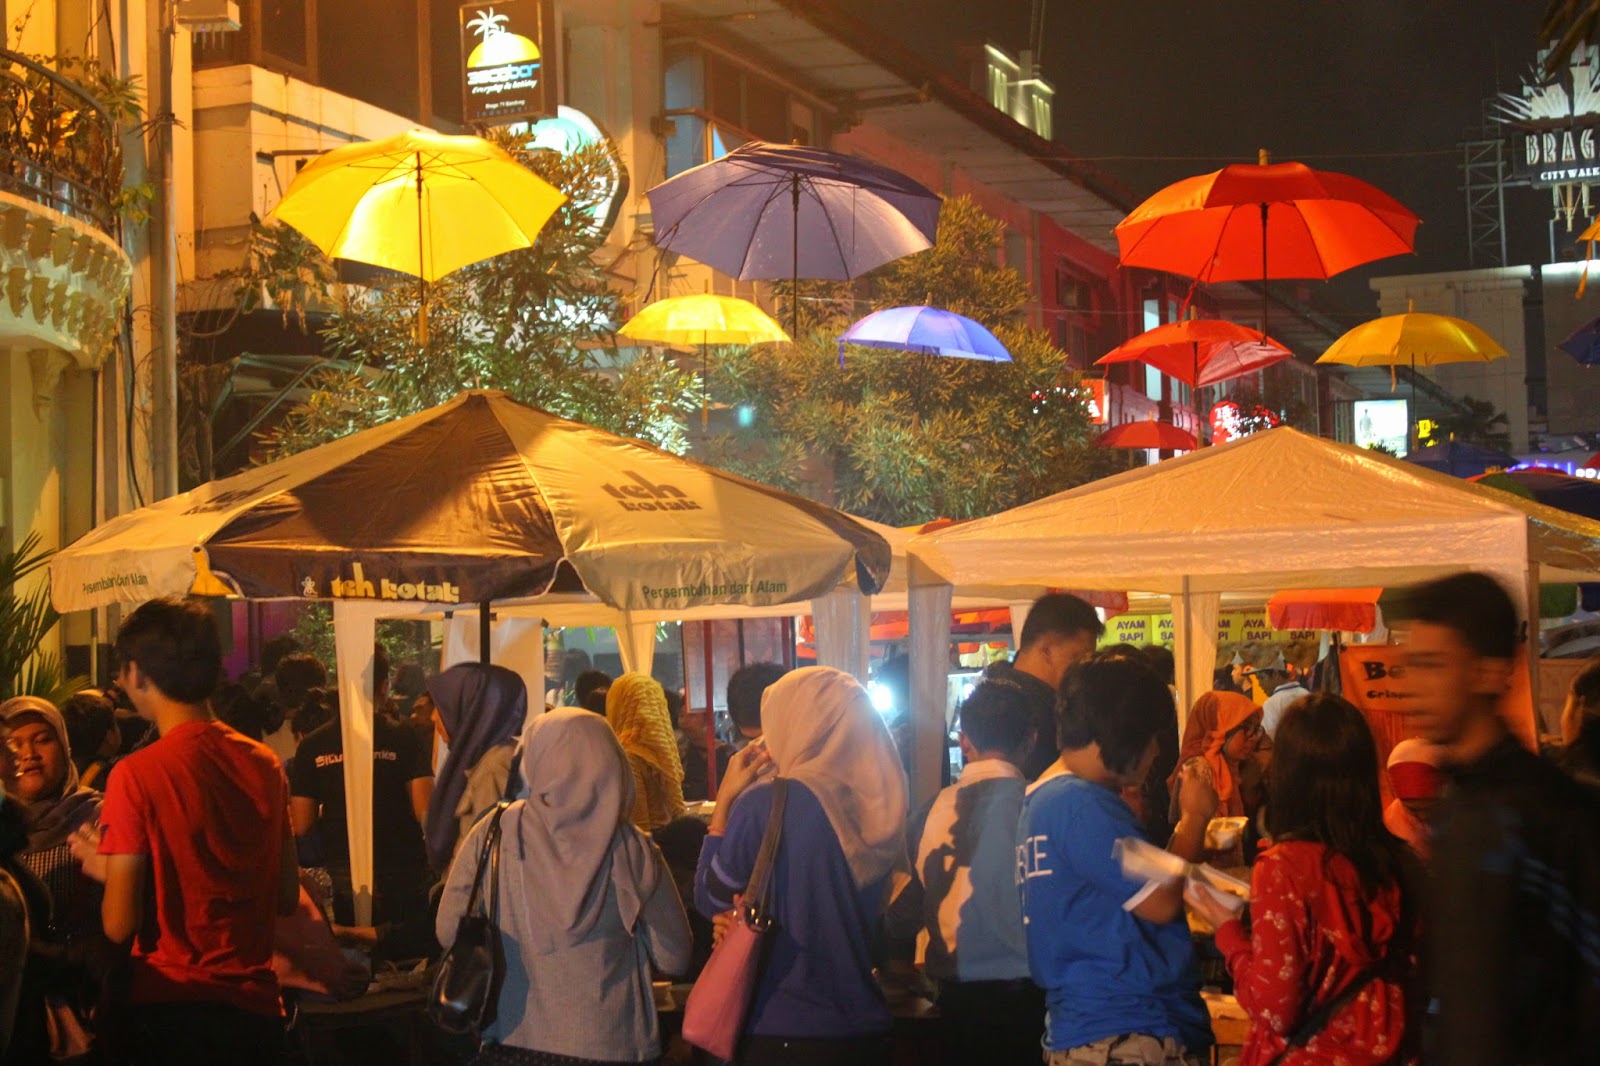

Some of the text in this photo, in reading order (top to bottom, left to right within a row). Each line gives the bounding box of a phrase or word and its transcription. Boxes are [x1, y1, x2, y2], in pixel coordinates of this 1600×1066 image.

[1525, 128, 1600, 165] BRAG
[1540, 167, 1600, 180] CITY WALK
[381, 578, 460, 603] kotak
[730, 580, 754, 594] dari
[756, 580, 787, 593] Alam
[1116, 620, 1146, 630] AYAM
[1158, 619, 1174, 629] AY
[1244, 619, 1266, 629] AYA
[1119, 632, 1144, 641] SAPI
[1160, 631, 1174, 640] SA
[1246, 631, 1272, 640] SAPI
[1290, 631, 1315, 640] SAPI
